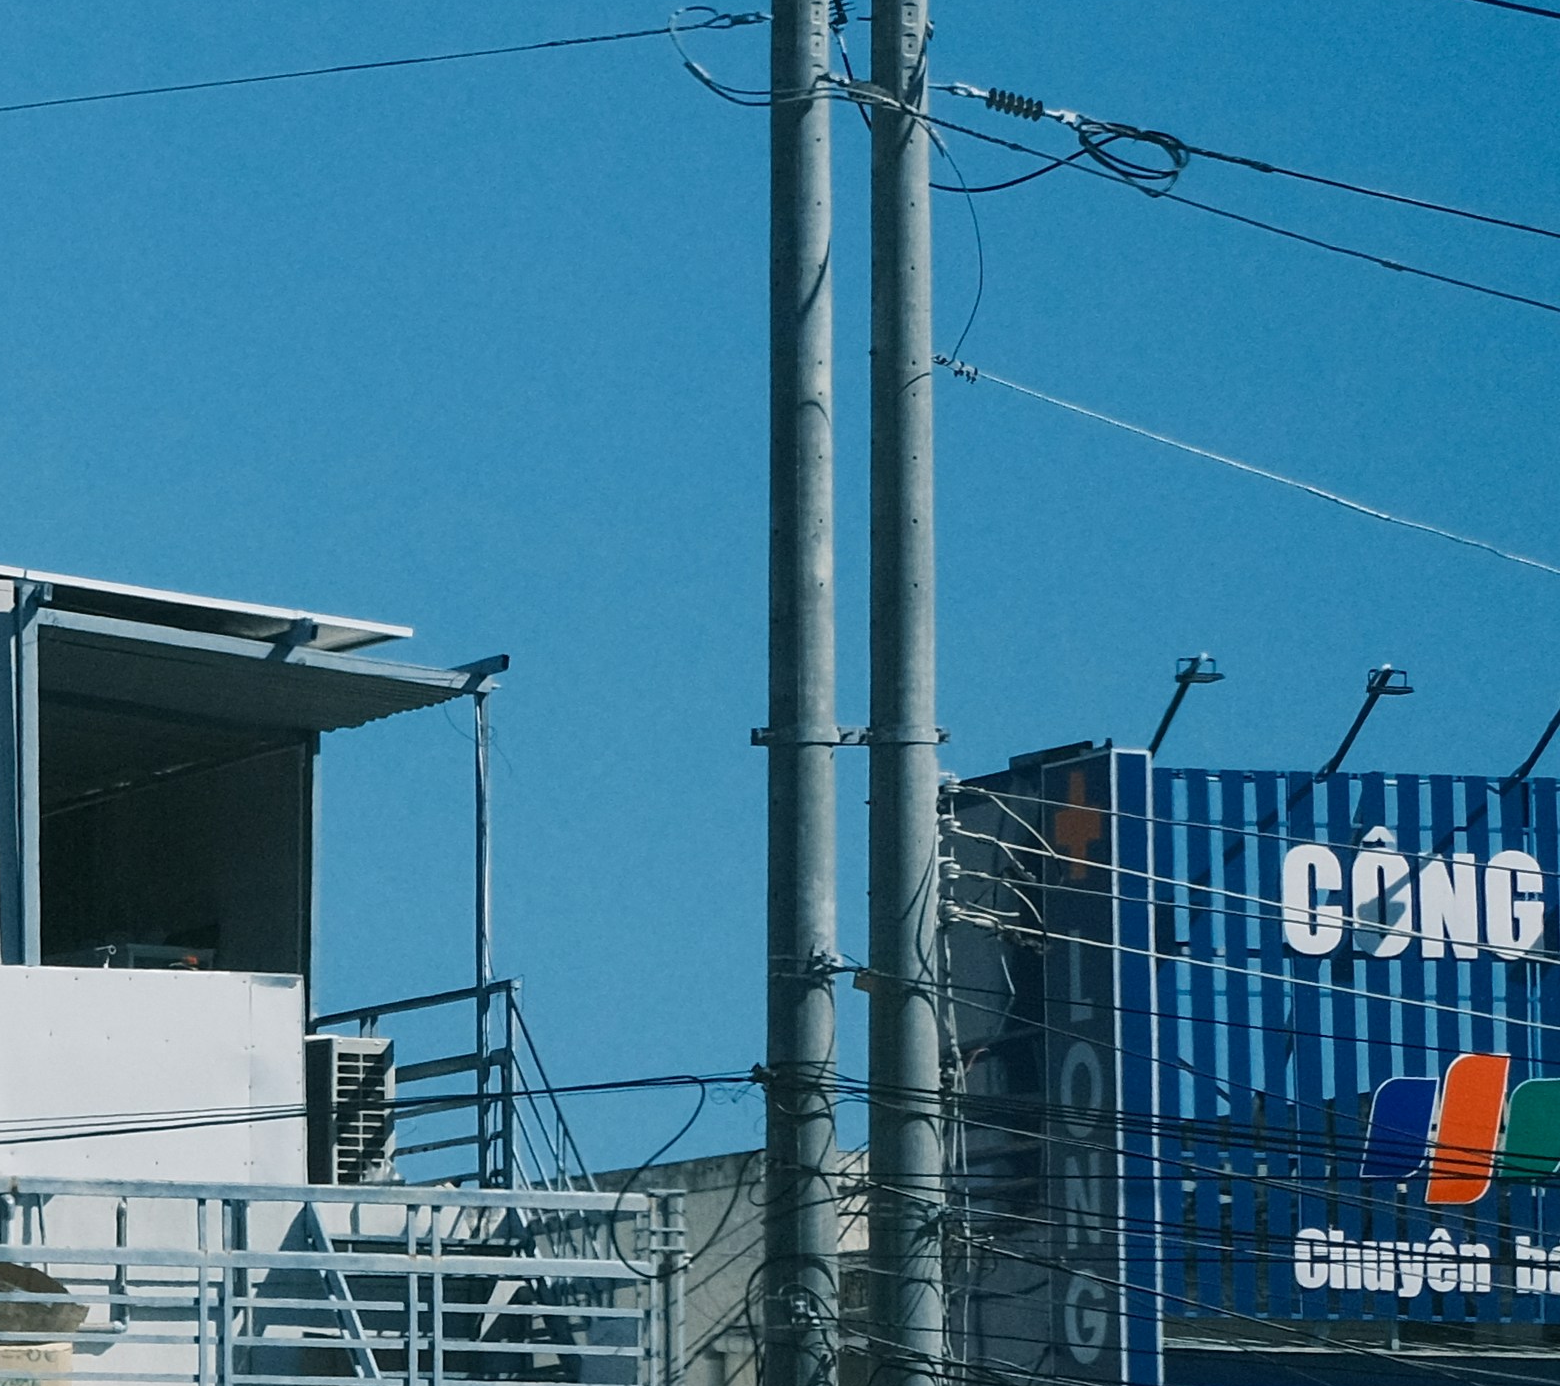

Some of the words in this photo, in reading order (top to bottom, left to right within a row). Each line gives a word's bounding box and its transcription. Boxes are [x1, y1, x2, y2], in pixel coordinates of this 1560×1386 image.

[1282, 826, 1544, 961] CÔNG
[1059, 929, 1107, 1365] LONG
[1294, 1227, 1491, 1298] Chuyên
